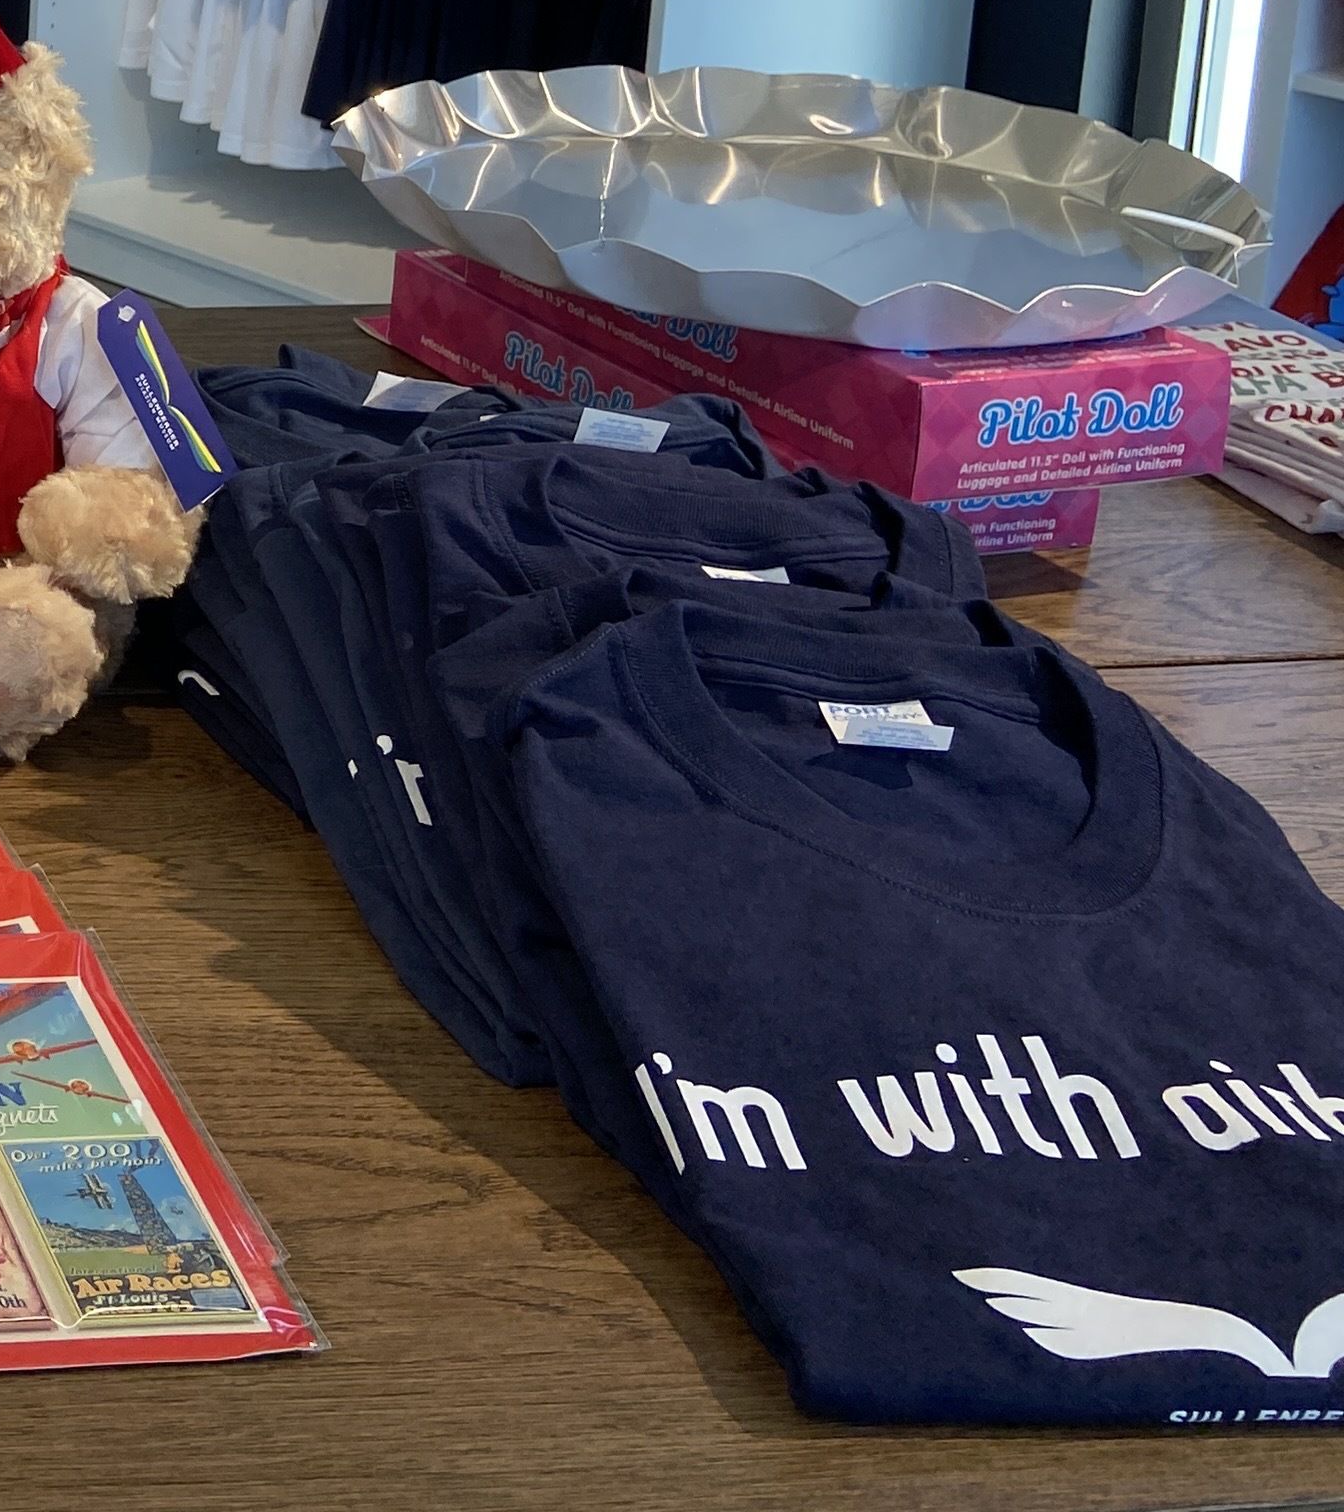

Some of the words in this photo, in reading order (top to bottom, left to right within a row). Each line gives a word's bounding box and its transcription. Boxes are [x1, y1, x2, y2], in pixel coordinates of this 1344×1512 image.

[1225, 334, 1307, 352] AVO
[505, 332, 565, 396] Pilot
[662, 348, 704, 377] Luggage
[706, 370, 727, 388] and
[728, 380, 771, 409] Detailed
[773, 401, 807, 427] Airline
[811, 420, 854, 450] Uniform
[977, 392, 1083, 448] Pilot
[1087, 382, 1183, 436] Doll
[957, 474, 1010, 491] Luggage
[1014, 470, 1036, 483] and
[1041, 466, 1091, 482] Detailed
[1094, 461, 1131, 475] Airline
[1135, 457, 1182, 472] Uniform
[960, 457, 1026, 475] Articulated
[1062, 451, 1085, 465] Doll
[1090, 449, 1114, 461] with
[1117, 443, 1185, 459] Functioning
[969, 523, 986, 534] ith
[989, 518, 1056, 533] Functioning
[1007, 532, 1053, 544] Uniform
[635, 1051, 808, 1177] I'm
[836, 1033, 1141, 1161] with
[10, 1149, 50, 1163] Over
[62, 1143, 132, 1159] 200
[39, 1160, 83, 1173] miles
[89, 1160, 117, 1170] per
[122, 1156, 163, 1167] hour
[73, 1276, 123, 1299] Air
[125, 1270, 231, 1292] Races
